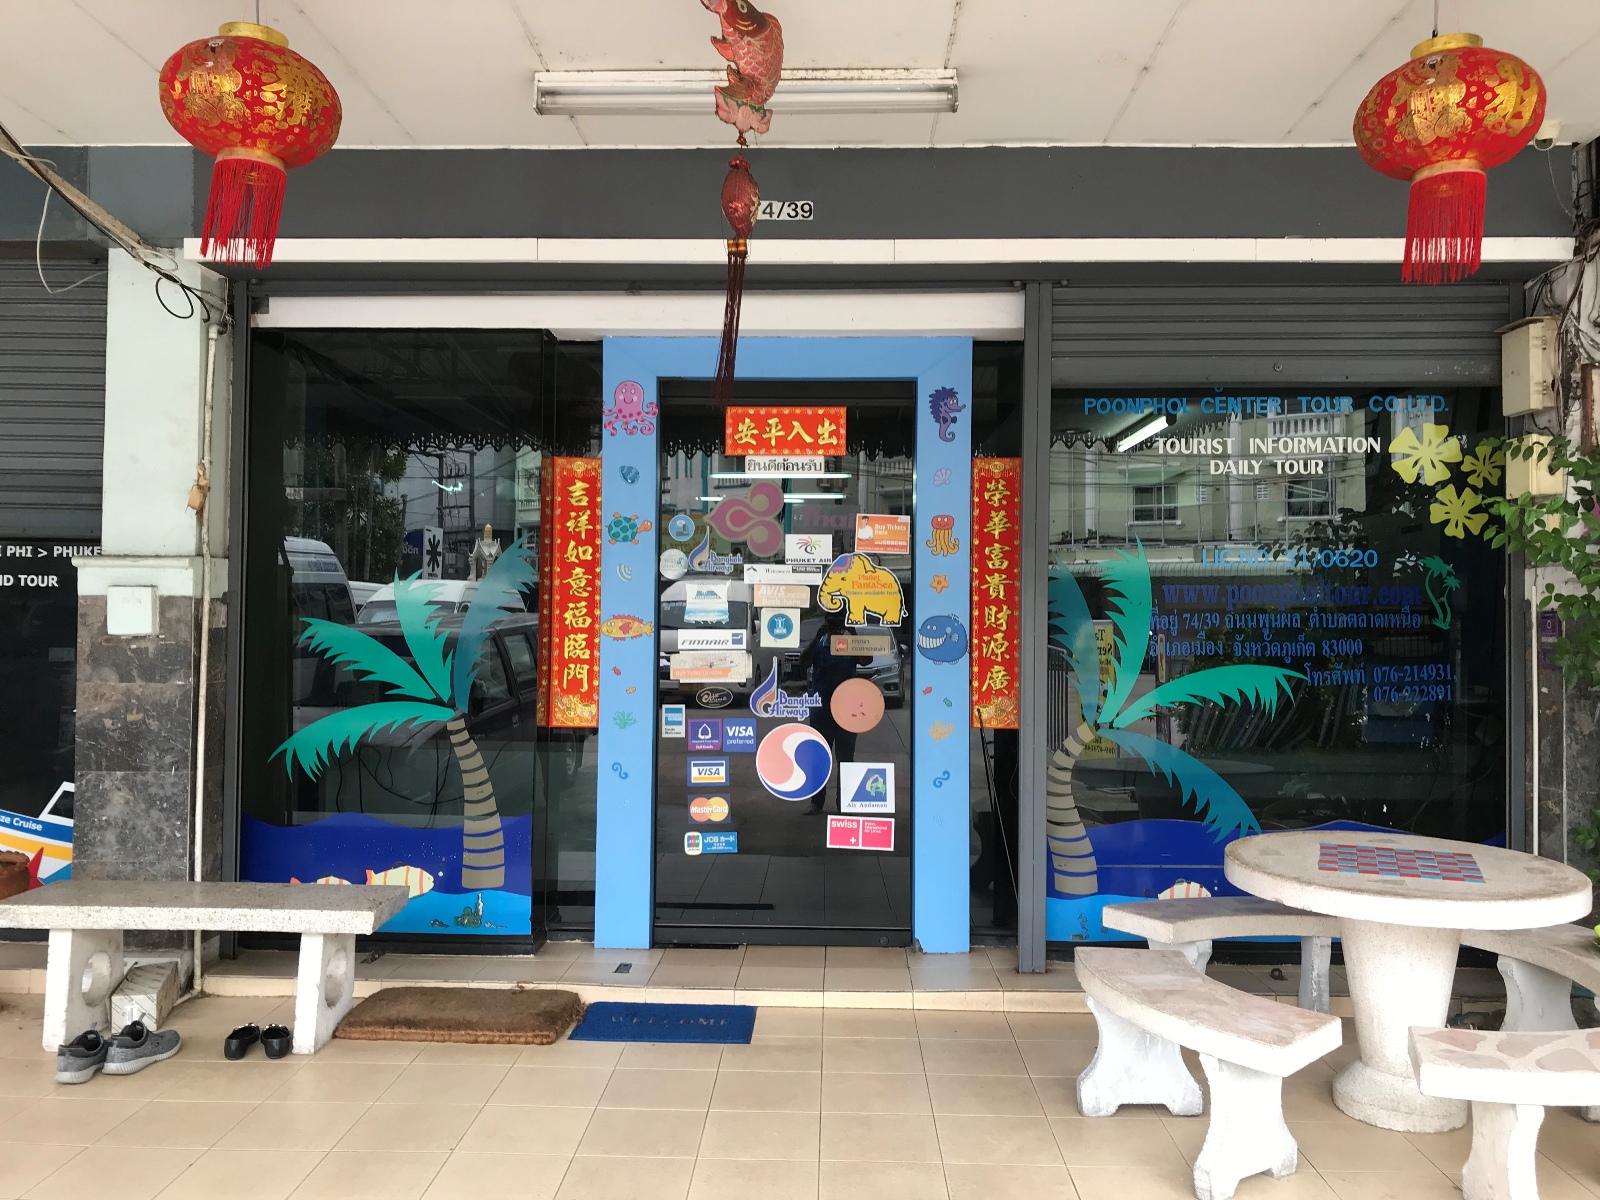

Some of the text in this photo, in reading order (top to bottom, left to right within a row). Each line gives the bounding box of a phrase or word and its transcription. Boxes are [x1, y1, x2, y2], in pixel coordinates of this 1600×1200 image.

[758, 201, 813, 219] 4/39
[1084, 397, 1192, 414] POONPHOL
[1201, 396, 1281, 414] CENTER
[1297, 396, 1353, 413] TOUR
[1155, 436, 1381, 454] TOURIST INFORMATION
[747, 458, 822, 472] ยินดีต้อนรับ
[1210, 459, 1324, 475] DAILY TOUR
[6, 545, 102, 557] PHI PHUKE
[710, 550, 742, 564] Bangkok
[1284, 548, 1379, 568] 31/0620
[703, 560, 733, 574] Airways
[18, 575, 58, 587] TOUR
[852, 579, 893, 589] FantaSea
[859, 574, 880, 582] Phuket
[561, 478, 594, 693] 吉祥如意福臨門
[759, 586, 786, 596] AVIS
[1162, 578, 1422, 611] www.poonpholtour.com
[1183, 613, 1220, 630] 74/39
[1322, 638, 1363, 657] 83000
[779, 689, 821, 708] Bangkok
[769, 701, 808, 720] Airways
[726, 726, 754, 736] VISA
[697, 768, 721, 776] VISA
[691, 805, 729, 814] MasterCard
[12, 817, 43, 831] Cruise
[831, 819, 858, 828] swiss
